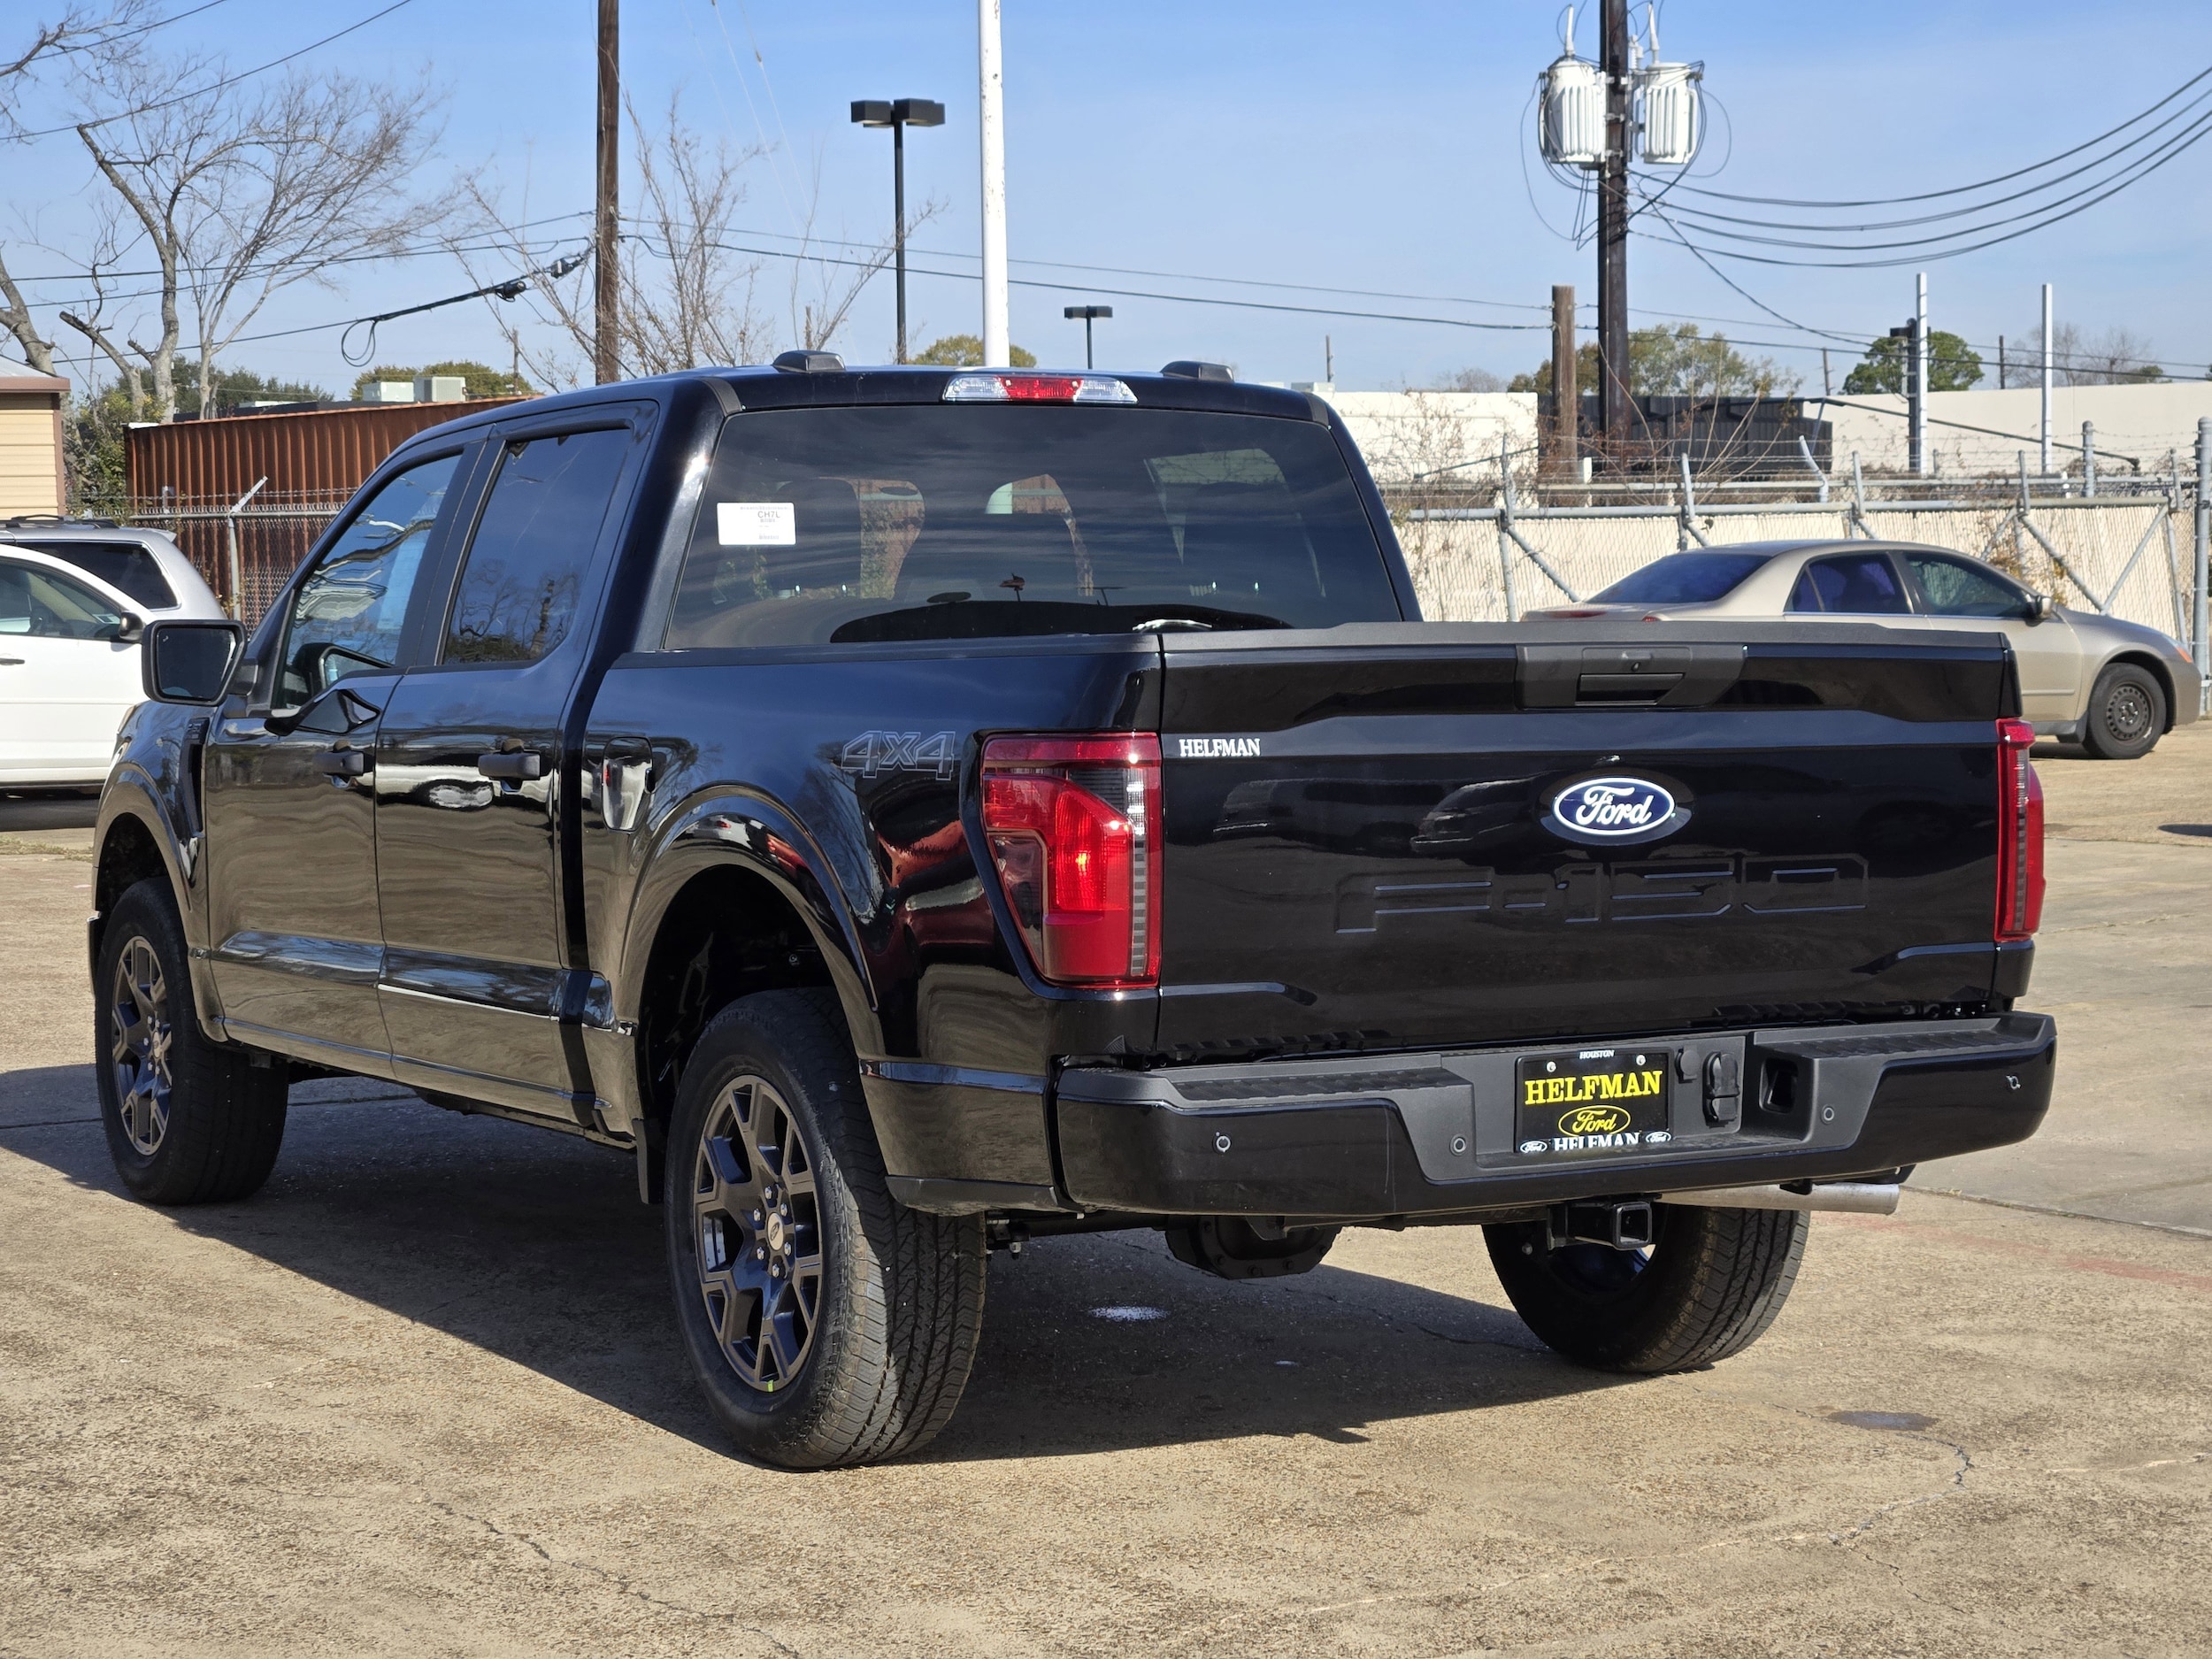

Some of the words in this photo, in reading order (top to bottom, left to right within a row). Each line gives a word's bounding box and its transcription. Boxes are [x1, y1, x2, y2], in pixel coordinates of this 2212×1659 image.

[1179, 738, 1261, 757] HELFMAN
[1576, 785, 1655, 826] Ford
[1333, 854, 1869, 933] F-150
[1579, 1049, 1615, 1060] HOUSTON
[1525, 1070, 1663, 1105] HELFMAN
[1571, 1109, 1617, 1133] Ford
